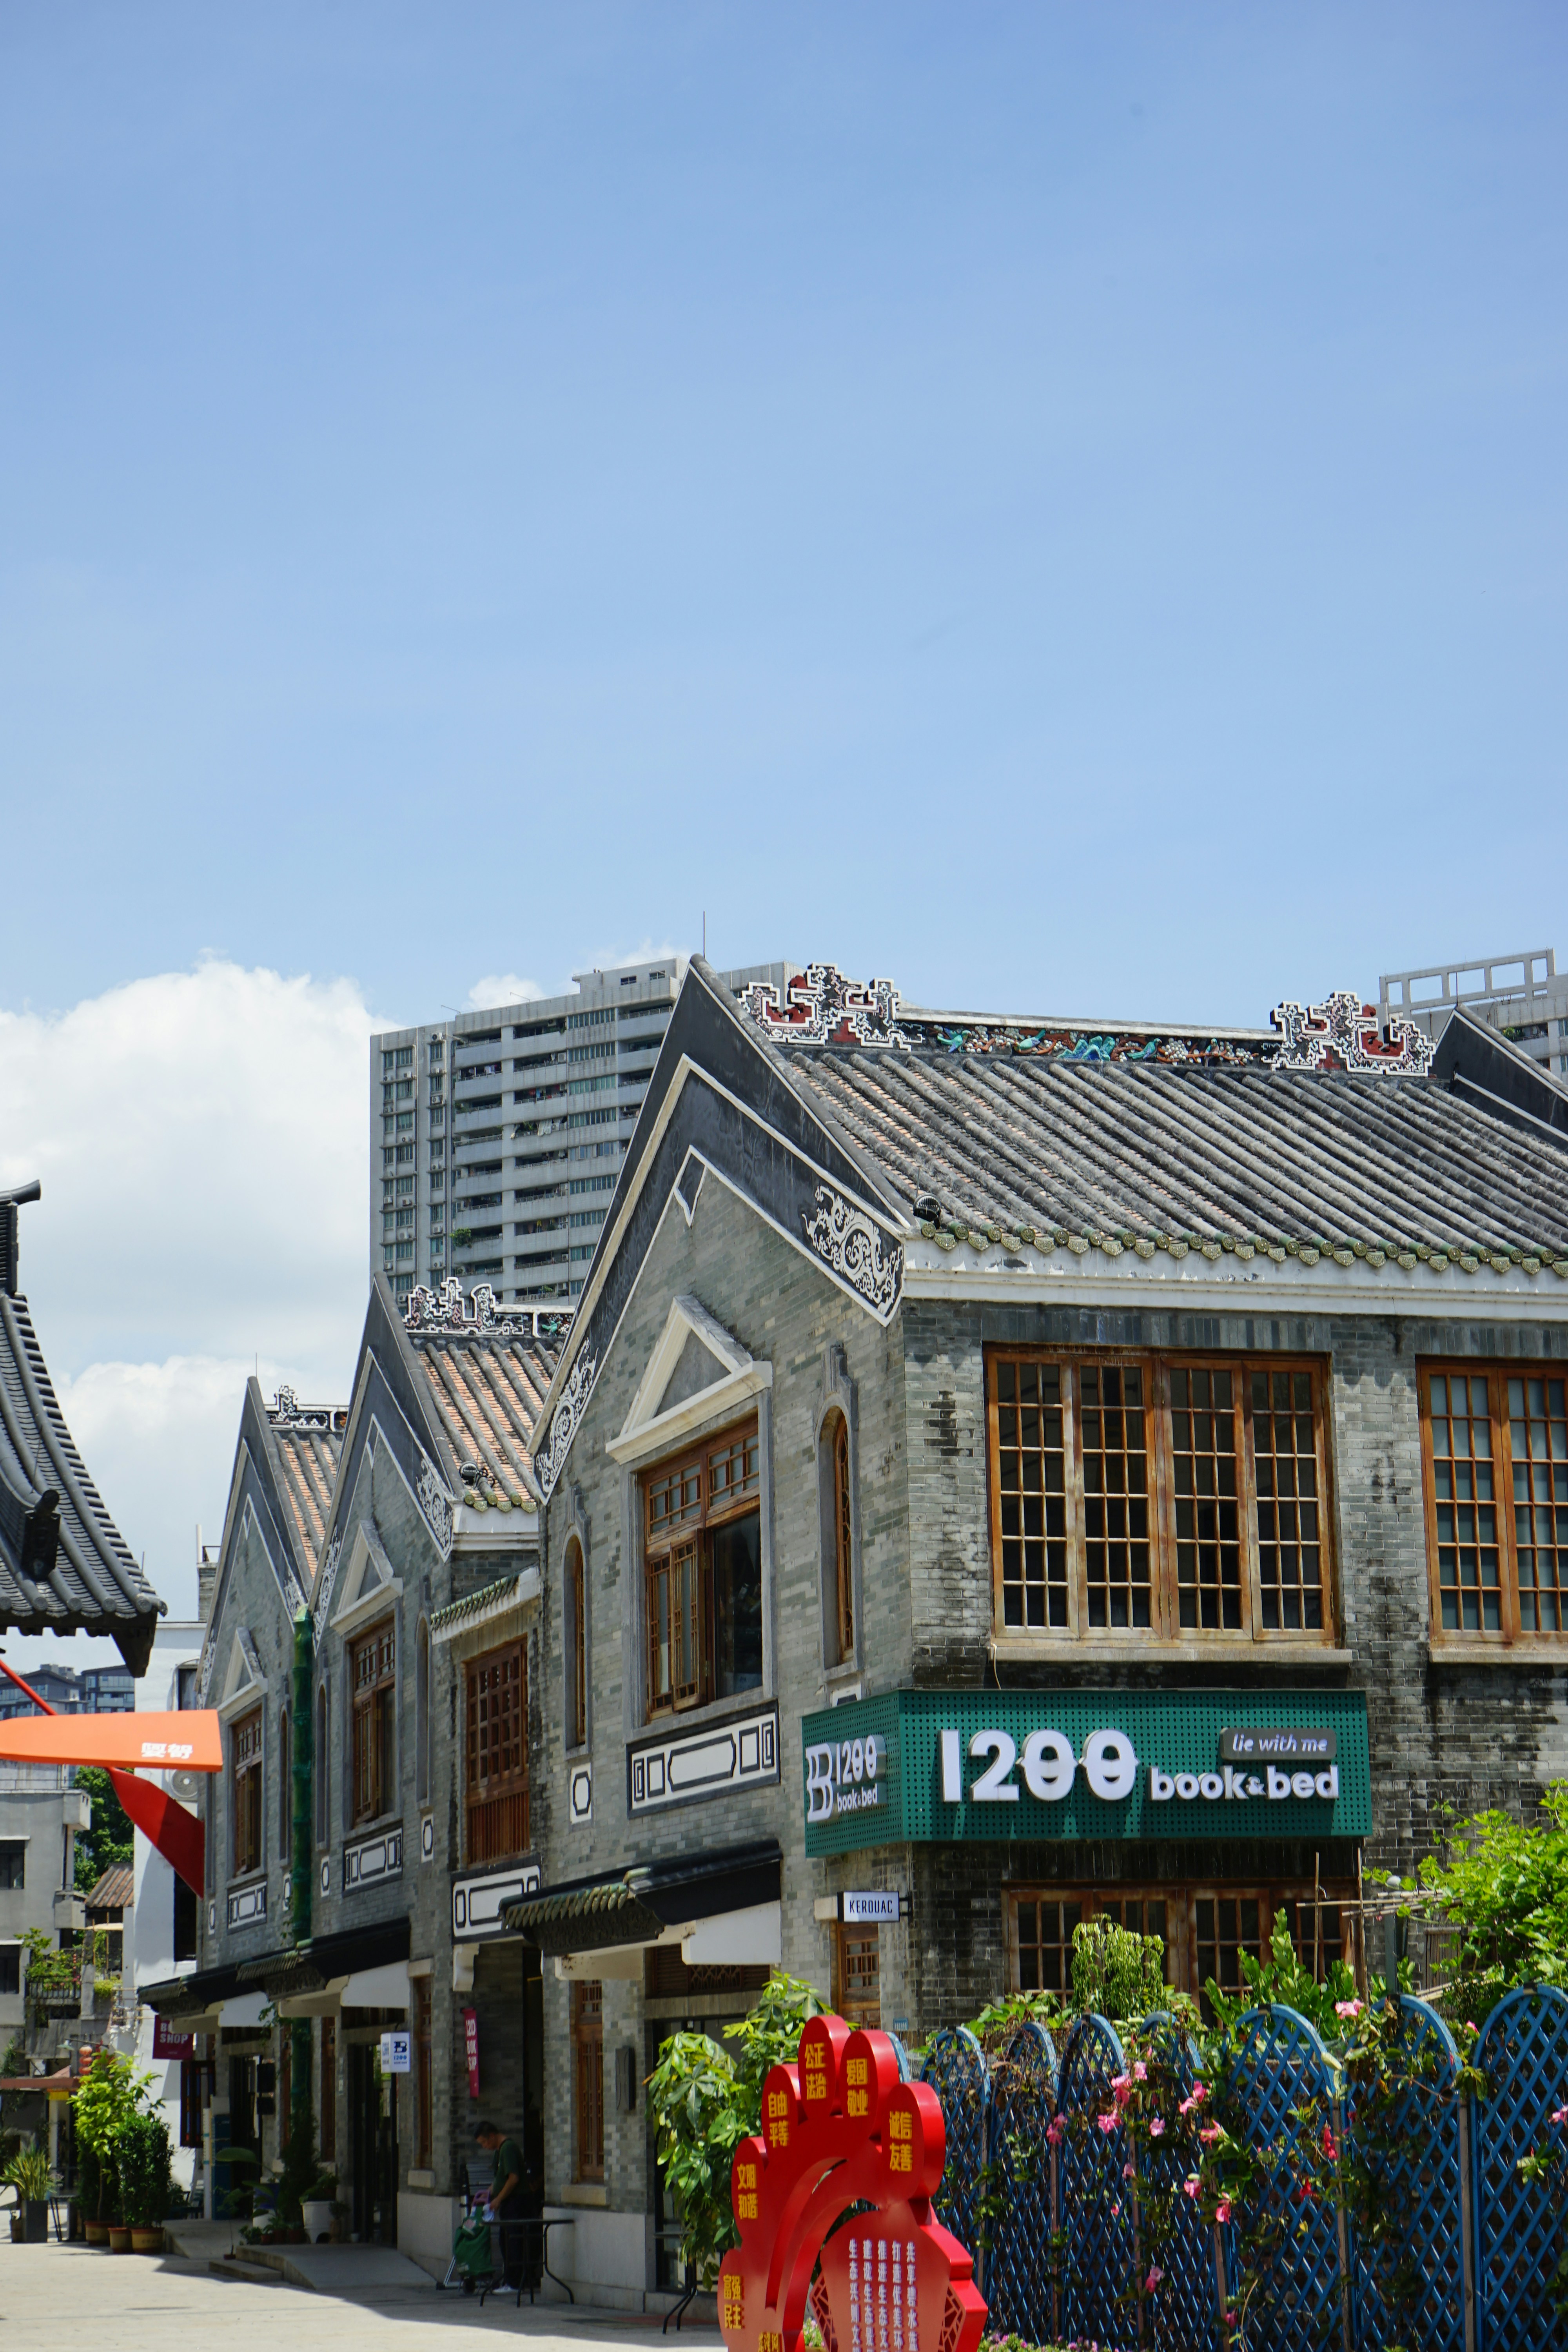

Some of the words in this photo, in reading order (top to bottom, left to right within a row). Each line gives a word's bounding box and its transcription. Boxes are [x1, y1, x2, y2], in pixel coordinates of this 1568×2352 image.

[1232, 1733, 1254, 1752] lie
[1259, 1733, 1297, 1752] with
[1301, 1737, 1328, 1752] me
[836, 1735, 877, 1785] 1200
[939, 1729, 1140, 1802] 1200
[1149, 1765, 1339, 1800] book&bed
[837, 1783, 878, 1812] book&bed
[849, 1900, 893, 1913] KEROUAC
[160, 2033, 188, 2044] SHOP
[804, 2042, 826, 2069] 公正
[846, 2058, 868, 2086] 爱国
[806, 2073, 827, 2100] 法治
[768, 2090, 788, 2118] 自由
[847, 2089, 868, 2117] 敬业
[769, 2120, 789, 2148] 平等
[889, 2111, 913, 2140] 诚信
[889, 2142, 913, 2172] 友善
[737, 2163, 757, 2190] 文明
[738, 2193, 758, 2220] 和谐
[723, 2274, 742, 2301] 富强
[849, 2238, 861, 2352] 生态兴则文
[863, 2238, 874, 2352] 建设生态景
[878, 2239, 889, 2352] 推进生态文
[724, 2304, 742, 2330] 民主
